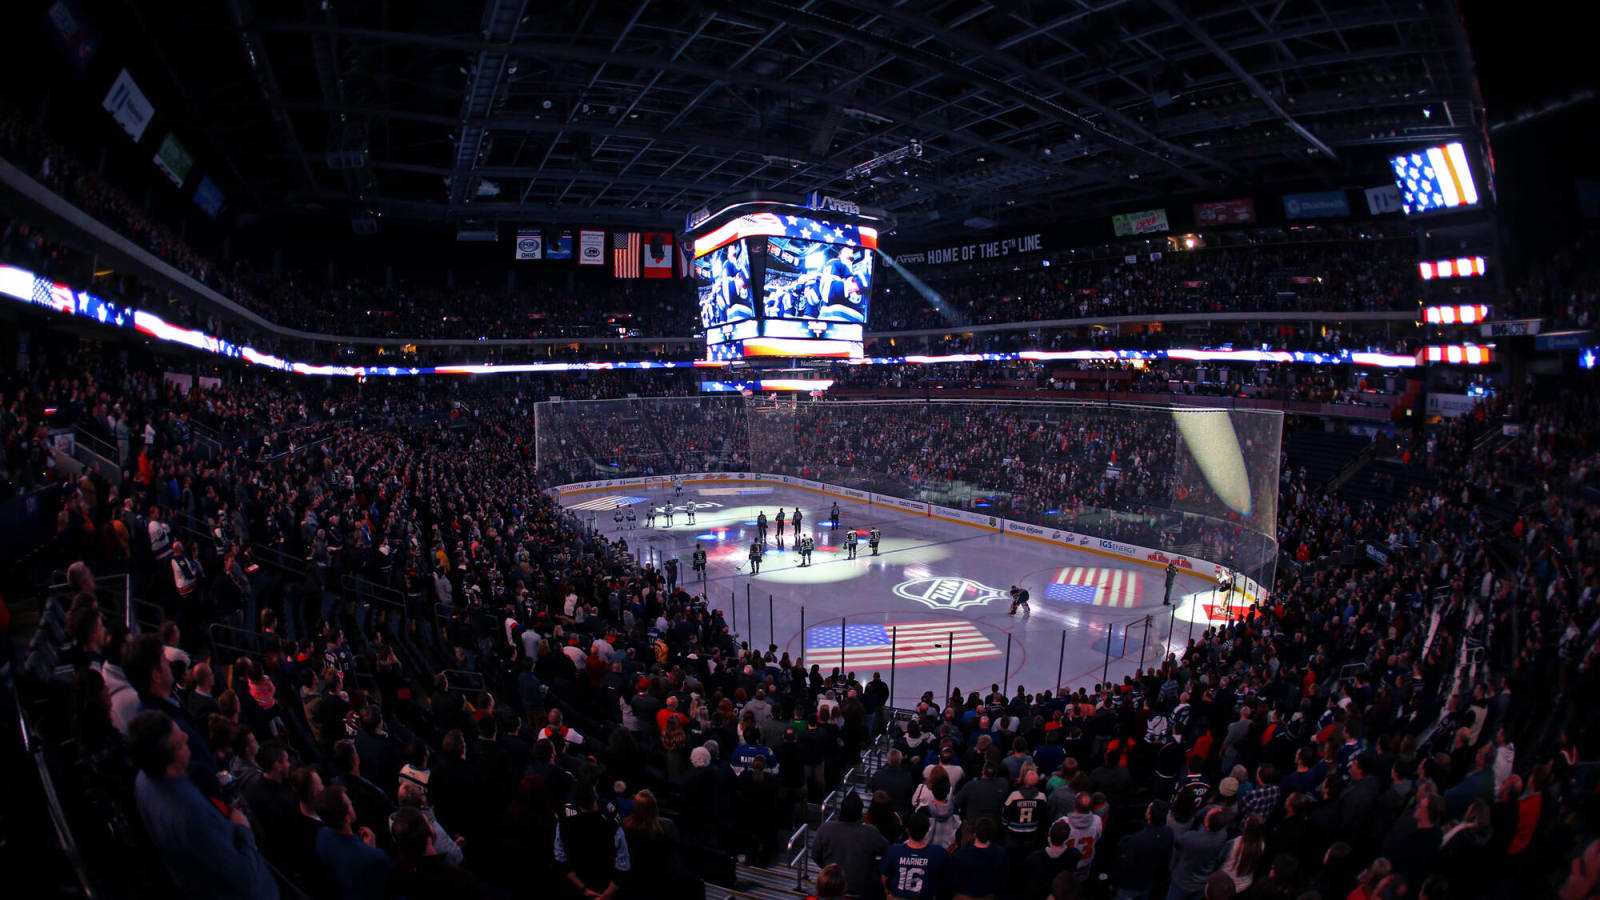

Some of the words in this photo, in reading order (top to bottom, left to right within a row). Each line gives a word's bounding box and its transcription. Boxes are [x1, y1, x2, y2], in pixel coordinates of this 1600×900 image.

[821, 195, 860, 215] Arena
[927, 247, 959, 264] HOME
[961, 245, 976, 261] OF
[979, 240, 999, 259] THE
[1017, 234, 1041, 253] LINE
[895, 254, 926, 265] Arena
[1099, 539, 1112, 549] IGS
[1112, 543, 1136, 554] ENERGY
[930, 580, 960, 602] NHL
[899, 856, 929, 867] MARNER
[897, 867, 925, 893] 16
